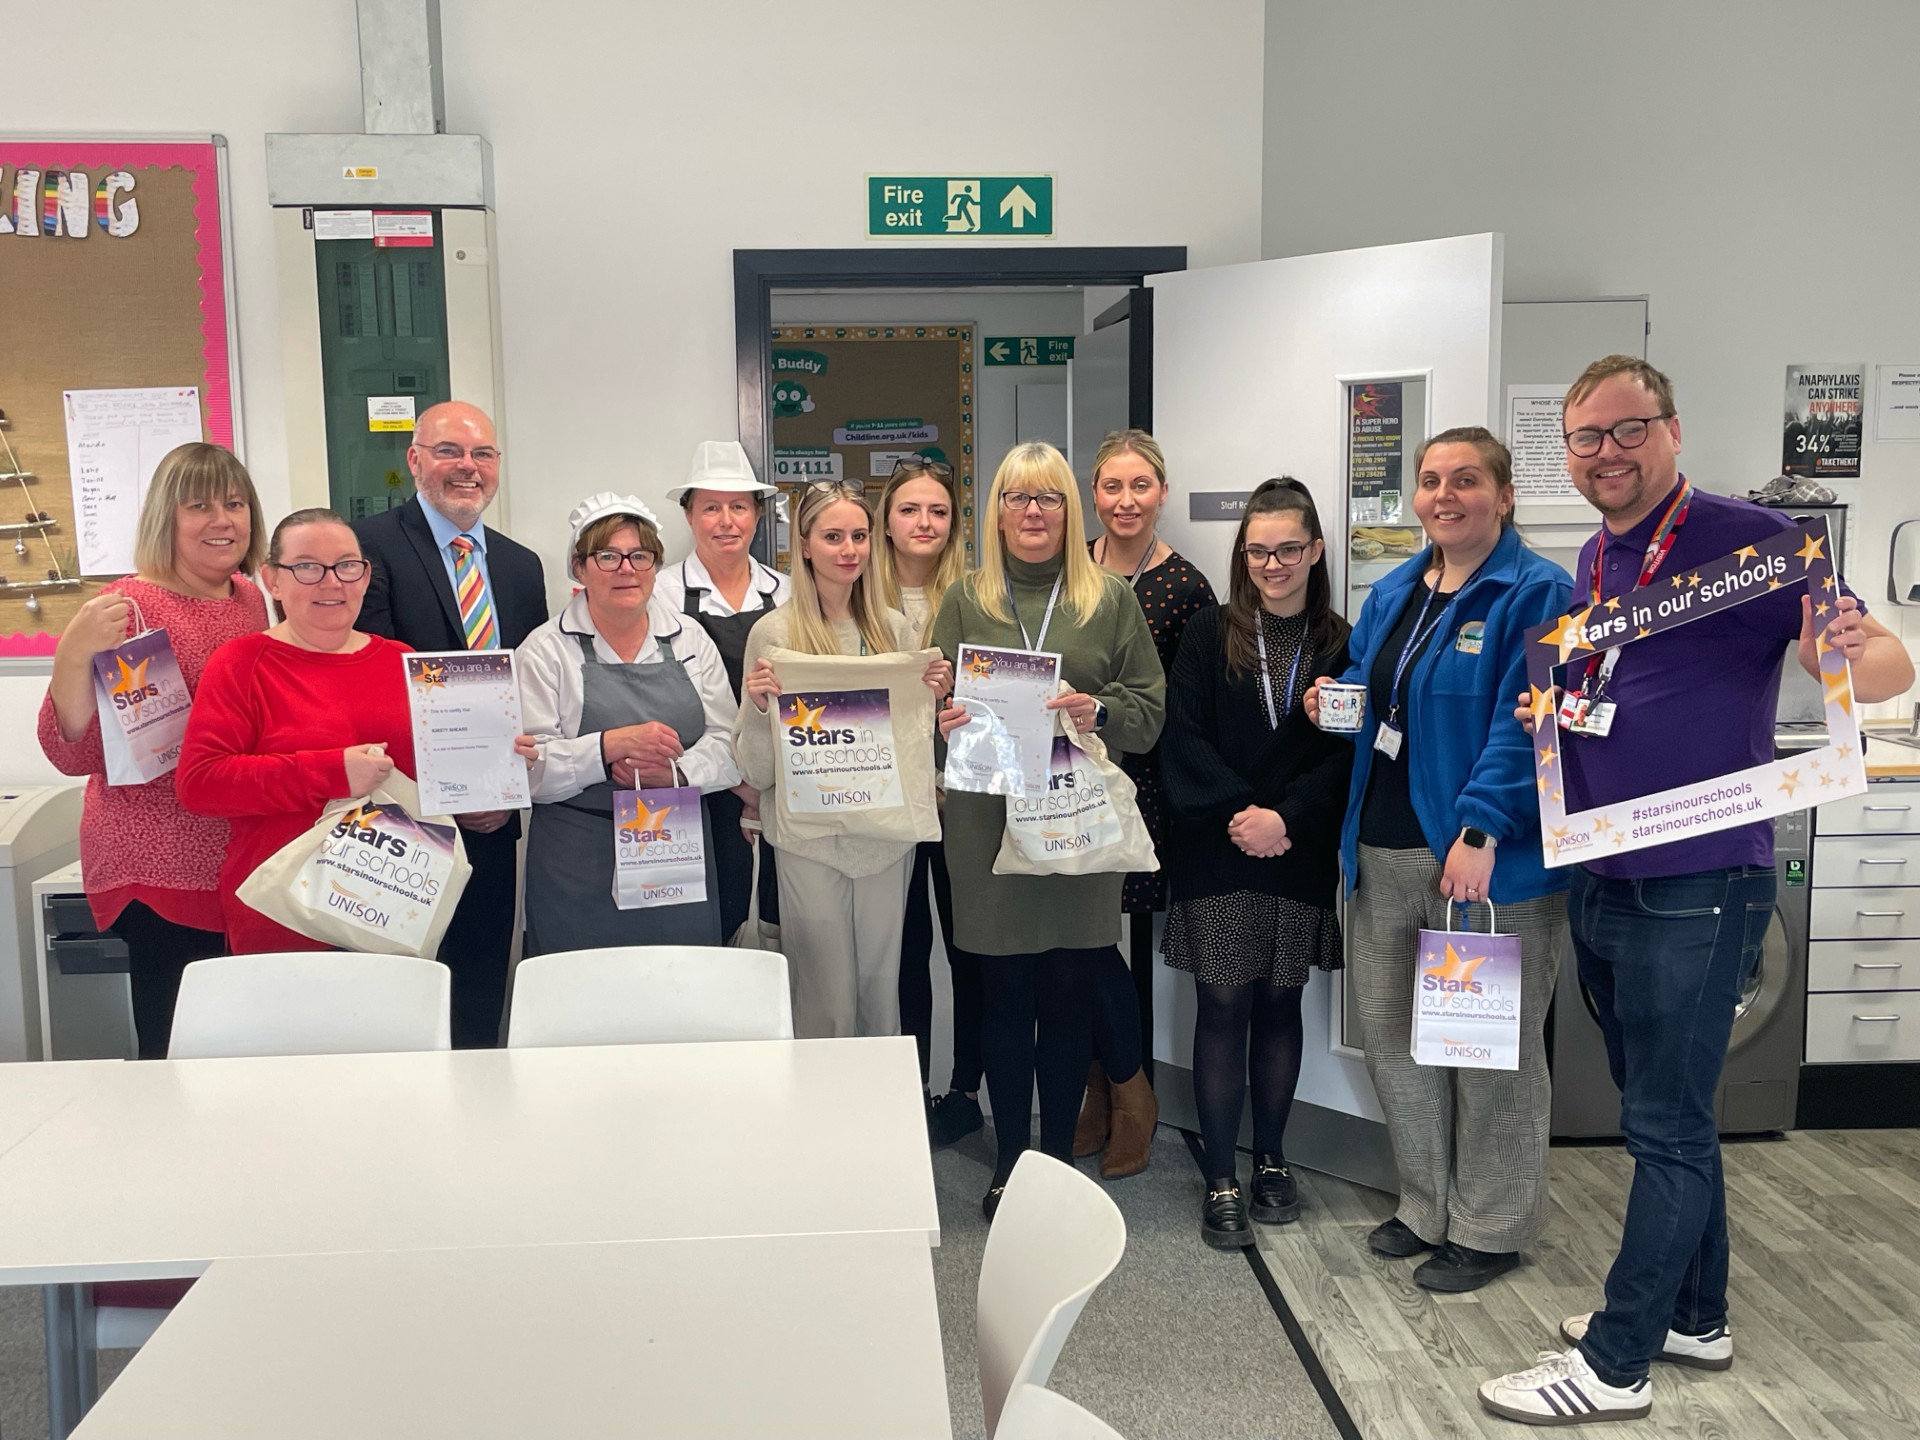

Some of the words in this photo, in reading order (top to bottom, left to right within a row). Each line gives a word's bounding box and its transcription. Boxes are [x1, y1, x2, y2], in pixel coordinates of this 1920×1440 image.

[884, 185, 924, 204] Fire
[885, 209, 923, 227] exit
[1048, 340, 1069, 350] Fire
[1049, 352, 1068, 361] exit
[778, 358, 822, 374] Buddy
[1799, 374, 1860, 387] ANAPHYLAXIS
[1808, 388, 1826, 400] CAN
[1828, 387, 1860, 400] STRIKE
[1809, 401, 1859, 414] ANYWHERE
[1361, 425, 1382, 433] ABUSE
[1382, 417, 1399, 425] HERO
[1796, 434, 1830, 453] 34%
[793, 461, 834, 475] 1111
[1220, 500, 1238, 510] Staff
[1239, 501, 1248, 510] Ro
[1648, 549, 1667, 575] VISITOR
[1563, 615, 1627, 650] stars
[1632, 606, 1652, 627] in
[1657, 589, 1694, 618] our
[1700, 554, 1787, 603] schools
[445, 663, 465, 673] You
[466, 663, 482, 673] are
[484, 663, 491, 672] a
[973, 664, 996, 675] Star
[995, 657, 1012, 668] You
[1013, 661, 1028, 669] are
[1030, 663, 1036, 671] a
[424, 674, 449, 684] Star
[113, 682, 159, 710] Stars
[121, 705, 140, 726] our
[142, 689, 187, 718] schools
[788, 726, 856, 747] Stars
[859, 726, 874, 743] in
[157, 745, 182, 764] UNISO
[790, 750, 820, 767] our
[824, 744, 892, 765] schools
[792, 764, 893, 776] www.starsinourschools.uk
[821, 790, 871, 806] UNISON
[1014, 797, 1045, 813] our
[1632, 781, 1752, 822] #starsinourschools
[1015, 800, 1107, 823] www.starsinourools.uk
[1631, 796, 1763, 839] starsinourschools.uk
[329, 819, 408, 858] Stars
[410, 844, 430, 868] in
[619, 827, 672, 844] Stars
[675, 828, 687, 840] in
[1045, 832, 1091, 852] UNISON
[1555, 832, 1590, 848] UNISON
[620, 846, 642, 859] our
[645, 841, 700, 857] schools
[320, 838, 355, 858] our
[355, 848, 440, 896] schools
[620, 855, 703, 866] www.starsinourschools.uk
[316, 858, 432, 907] www.starsinourschools.uk
[643, 887, 683, 900] UNISON
[328, 891, 390, 928] UNISON
[1422, 974, 1483, 993] Stars
[1487, 979, 1501, 994] in
[1421, 994, 1445, 1008] our
[1451, 994, 1514, 1012] schools
[1421, 1010, 1517, 1021] www.starsinourschools.uk
[1445, 1046, 1491, 1058] UNISON
